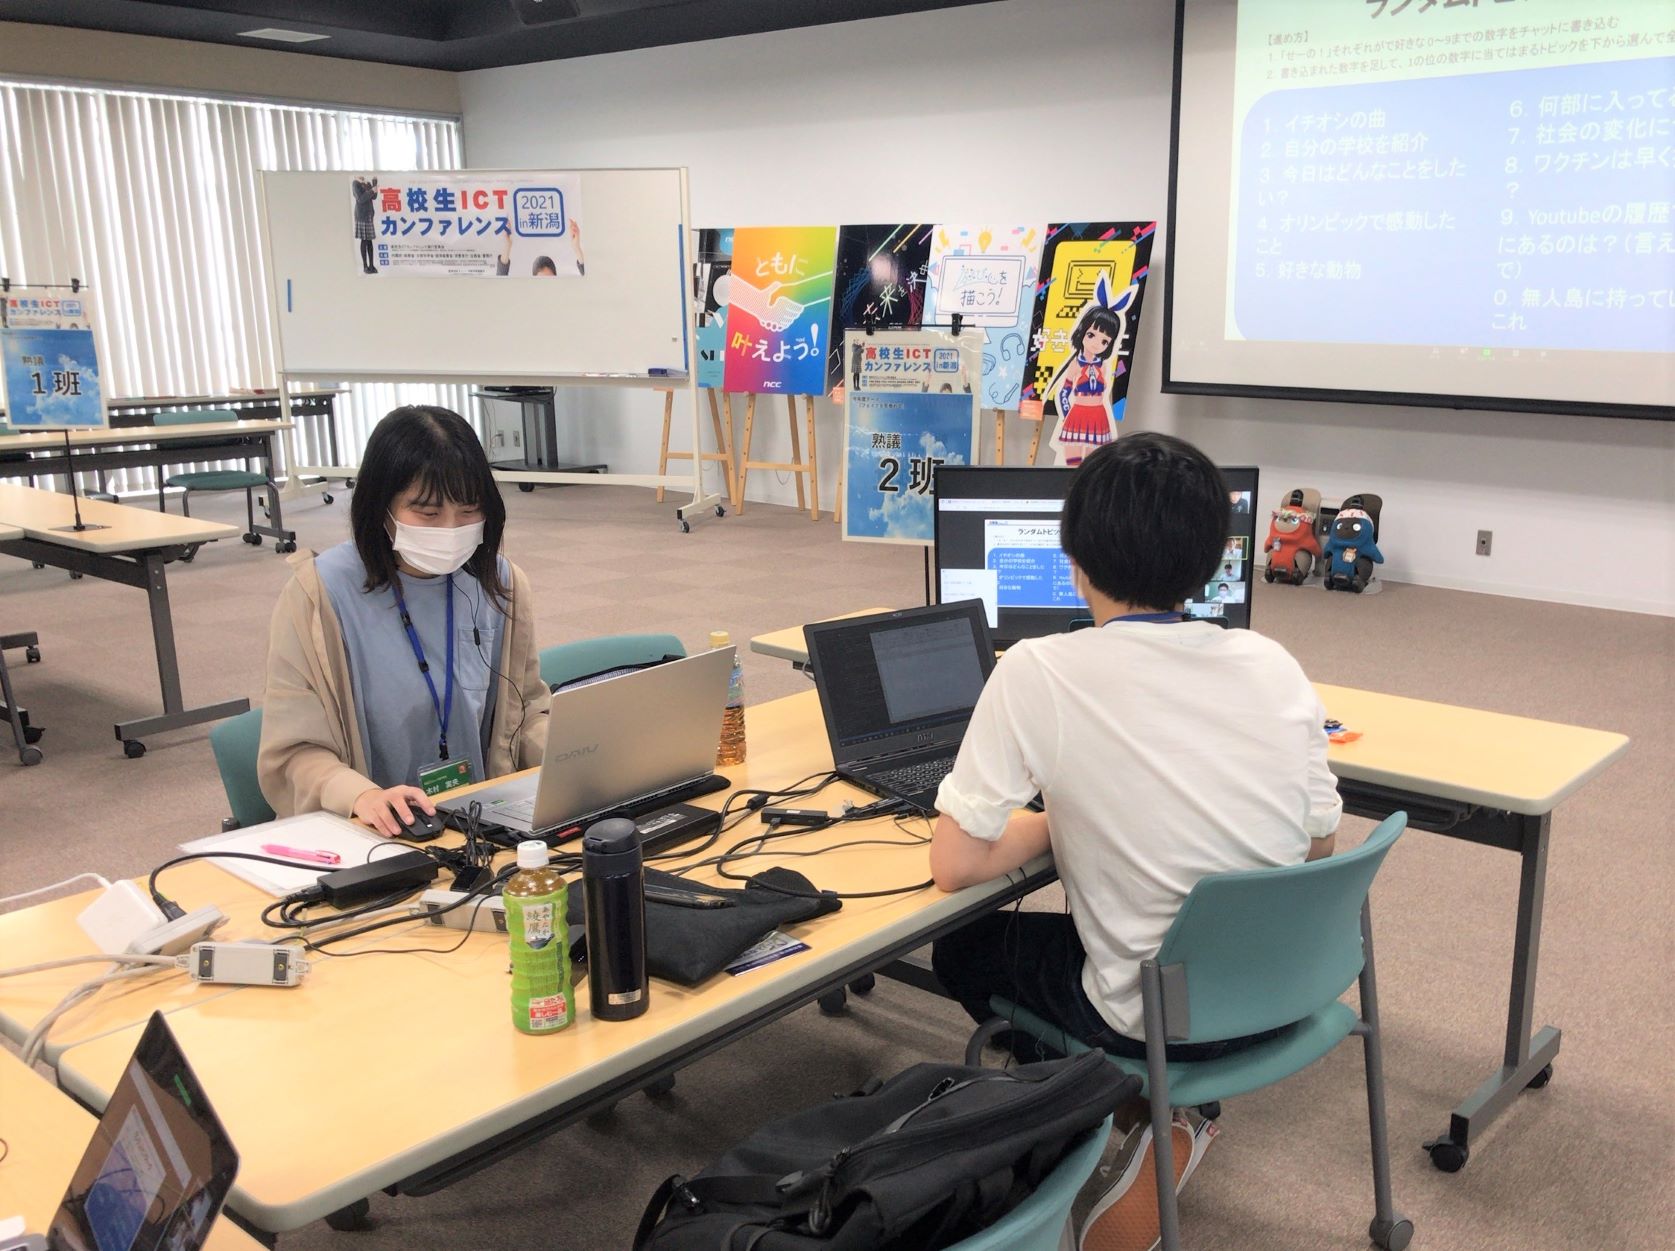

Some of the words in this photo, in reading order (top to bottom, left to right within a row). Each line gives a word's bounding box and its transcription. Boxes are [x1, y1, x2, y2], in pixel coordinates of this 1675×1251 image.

[1285, 108, 1386, 132] イチオシの曲
[1536, 117, 1675, 145] 社会の変化に
[1285, 131, 1429, 157] 自分の学校を紹介
[1282, 158, 1467, 183] 今日はどんなことをした
[1535, 145, 1675, 174] ワクチンは早く
[380, 187, 508, 213] 高校生ICT
[521, 195, 554, 210] 2021
[1280, 210, 1456, 232] オリンピックで感動した
[1528, 201, 1675, 225] Youtubeの履歴
[381, 216, 512, 236] カンファレンス
[1256, 238, 1282, 255] こと
[756, 252, 808, 277] ともに
[1278, 260, 1362, 280] 好きな動物
[960, 287, 1003, 308] 描こう！
[1491, 311, 1527, 331] これ
[731, 323, 820, 362] 叶えよう！
[865, 347, 932, 360] 高校生ICT
[865, 361, 932, 373] カンファレンス
[32, 372, 81, 396] 1班
[872, 433, 901, 449] 熟議
